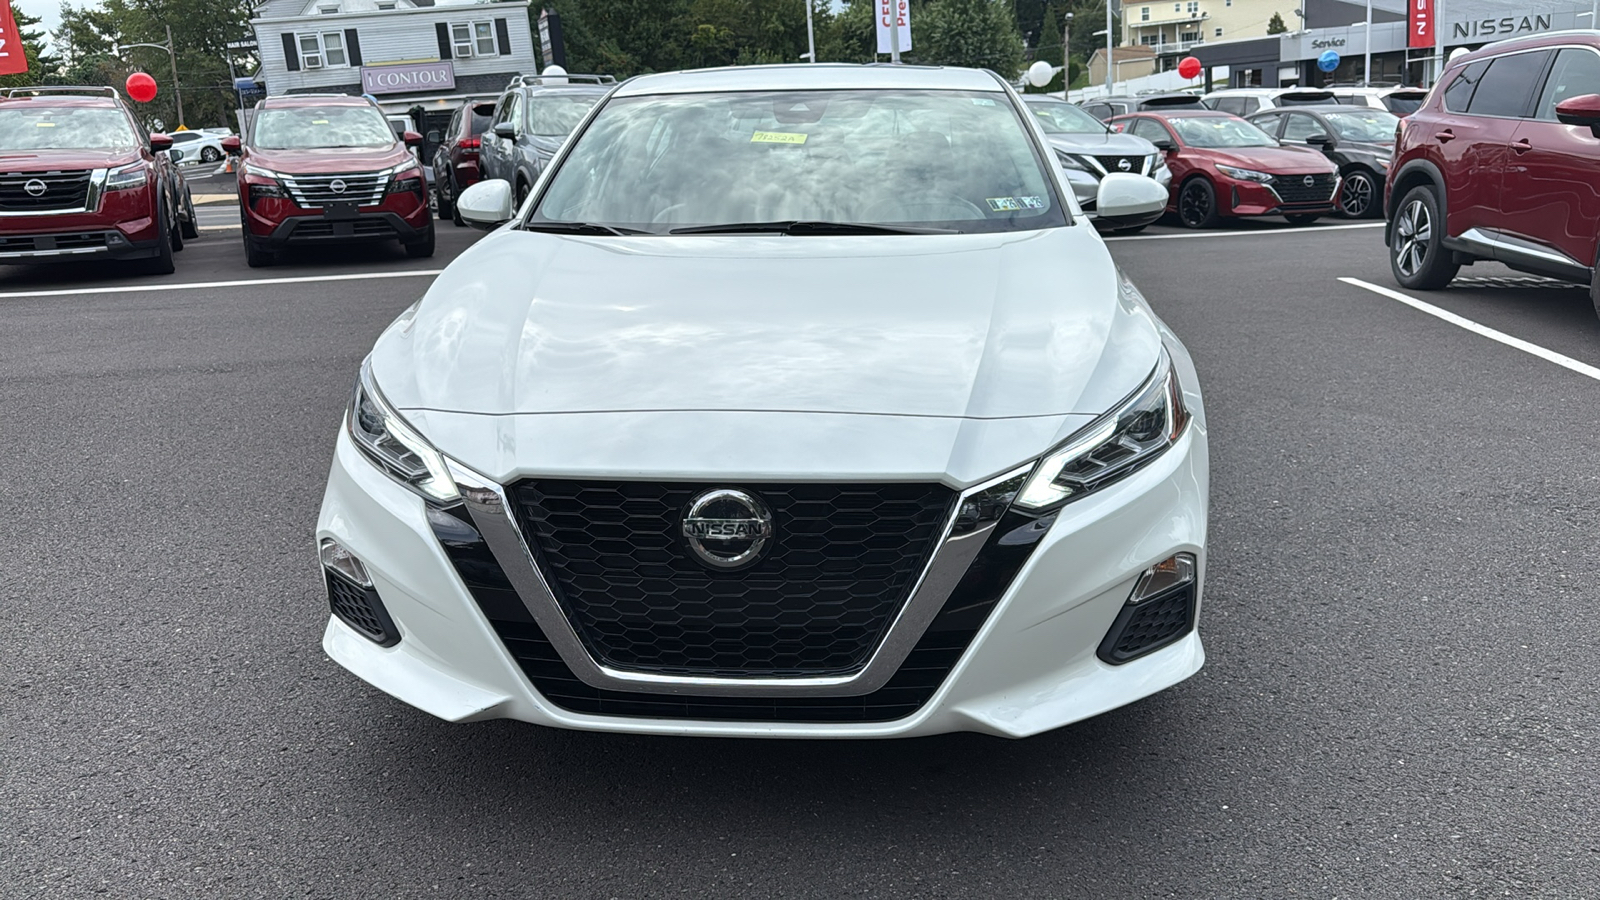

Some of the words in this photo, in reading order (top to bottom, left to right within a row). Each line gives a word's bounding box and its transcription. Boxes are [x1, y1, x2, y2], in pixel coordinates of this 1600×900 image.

[1453, 14, 1551, 39] NISSAN
[1311, 37, 1345, 49] Service
[377, 70, 447, 86] CONTOUR
[692, 523, 761, 536] NISSAN
